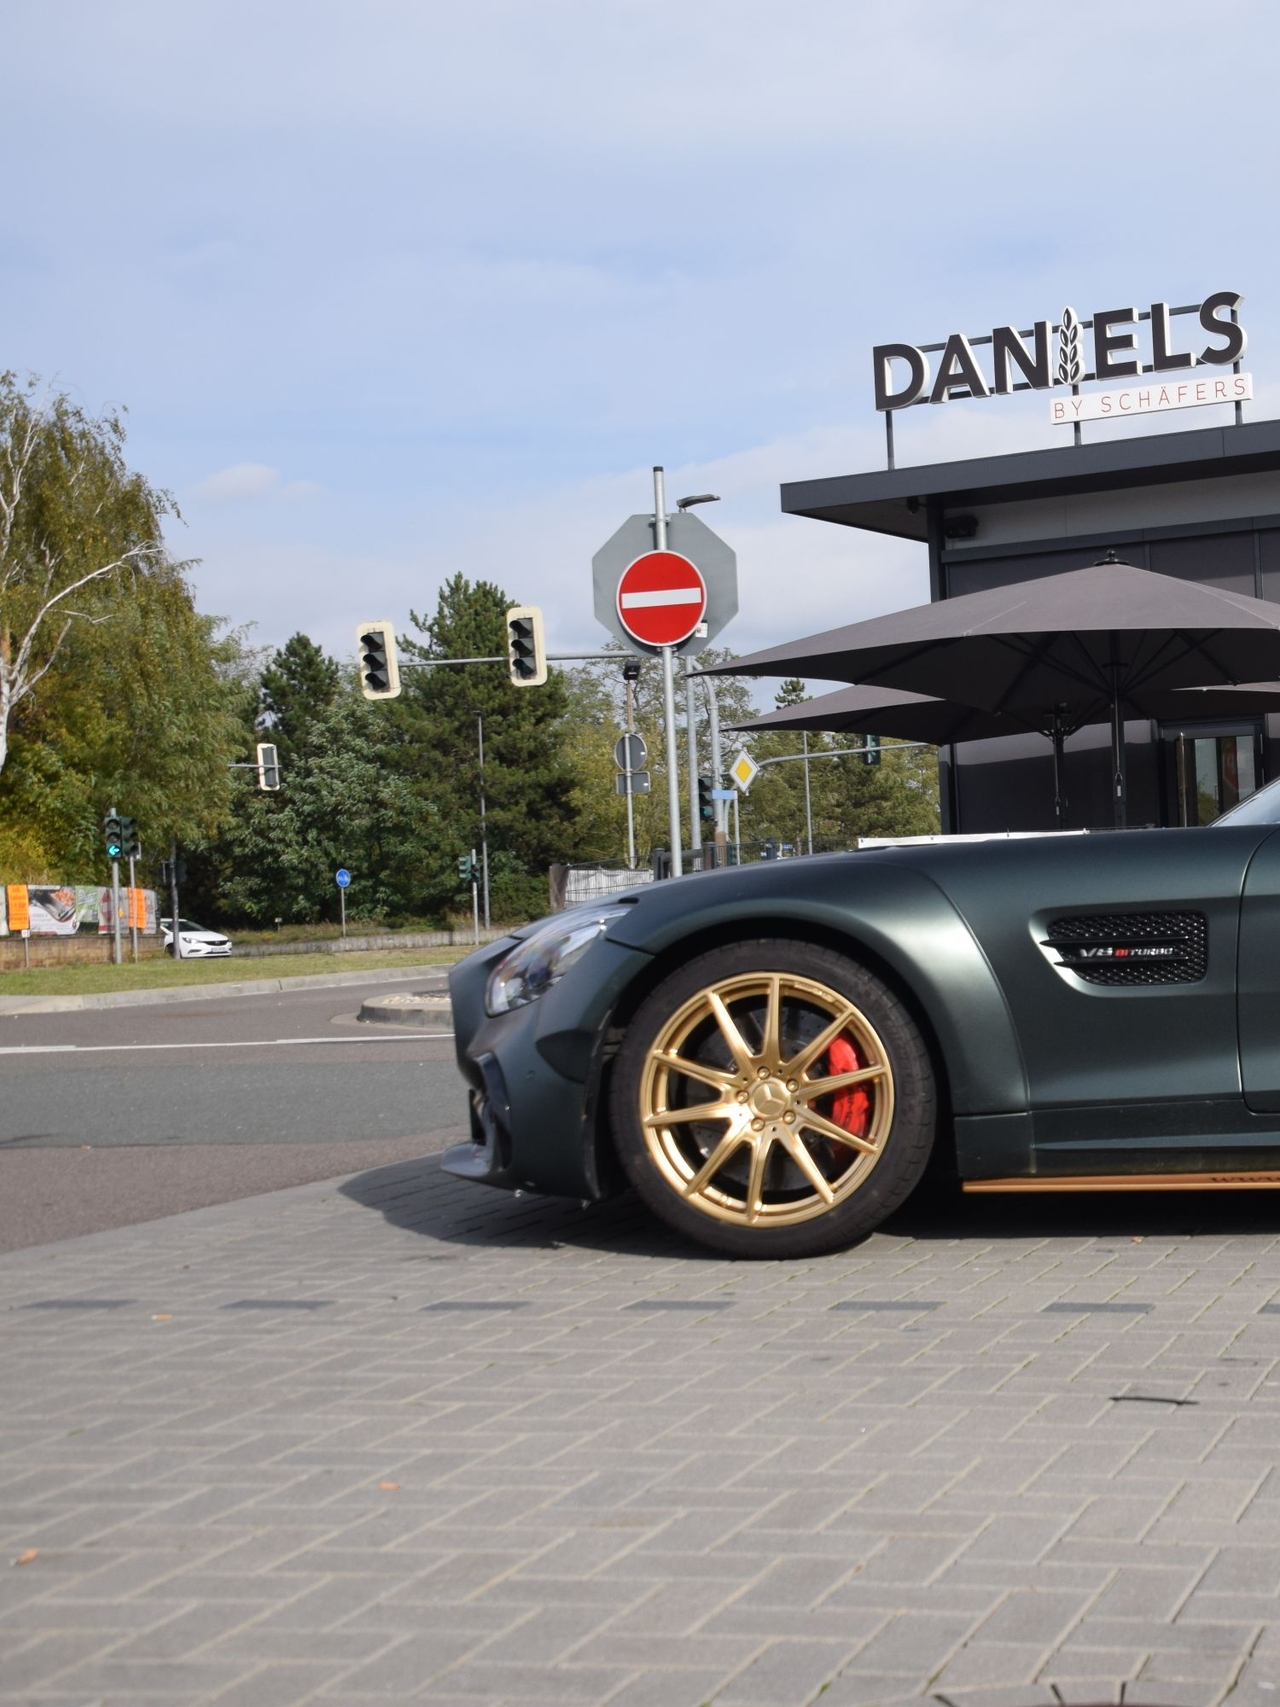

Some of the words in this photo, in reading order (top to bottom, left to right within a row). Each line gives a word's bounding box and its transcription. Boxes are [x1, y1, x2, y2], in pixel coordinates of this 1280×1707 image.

[873, 291, 1248, 412] DANIELS
[1053, 399, 1083, 420] BY
[1100, 378, 1247, 413] SCHÄFERS
